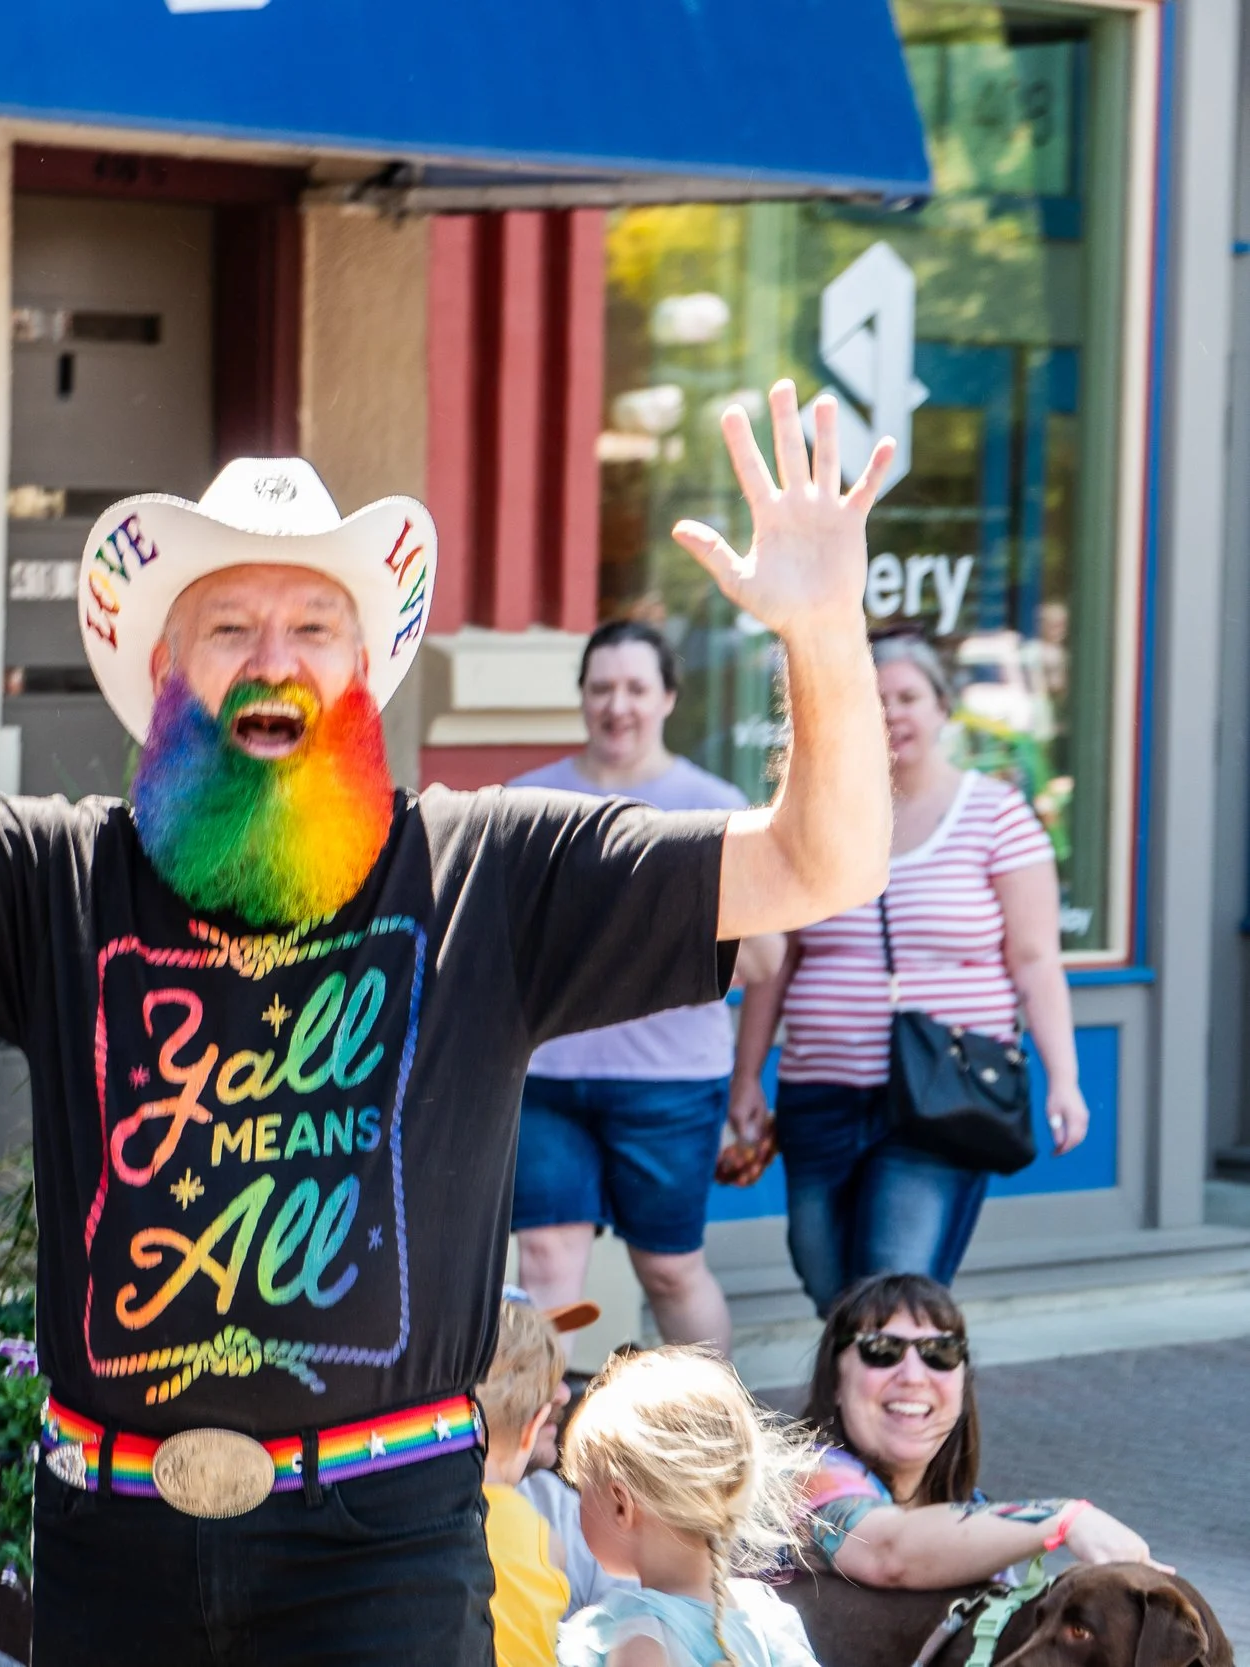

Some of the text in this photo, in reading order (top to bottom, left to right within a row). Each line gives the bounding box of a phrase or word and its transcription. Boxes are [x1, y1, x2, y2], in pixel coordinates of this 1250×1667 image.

[86, 511, 159, 651] LOVE
[385, 517, 427, 658] LOVE
[866, 552, 974, 636] ery
[211, 1105, 381, 1167] MEANS
[115, 1173, 360, 1330] All
